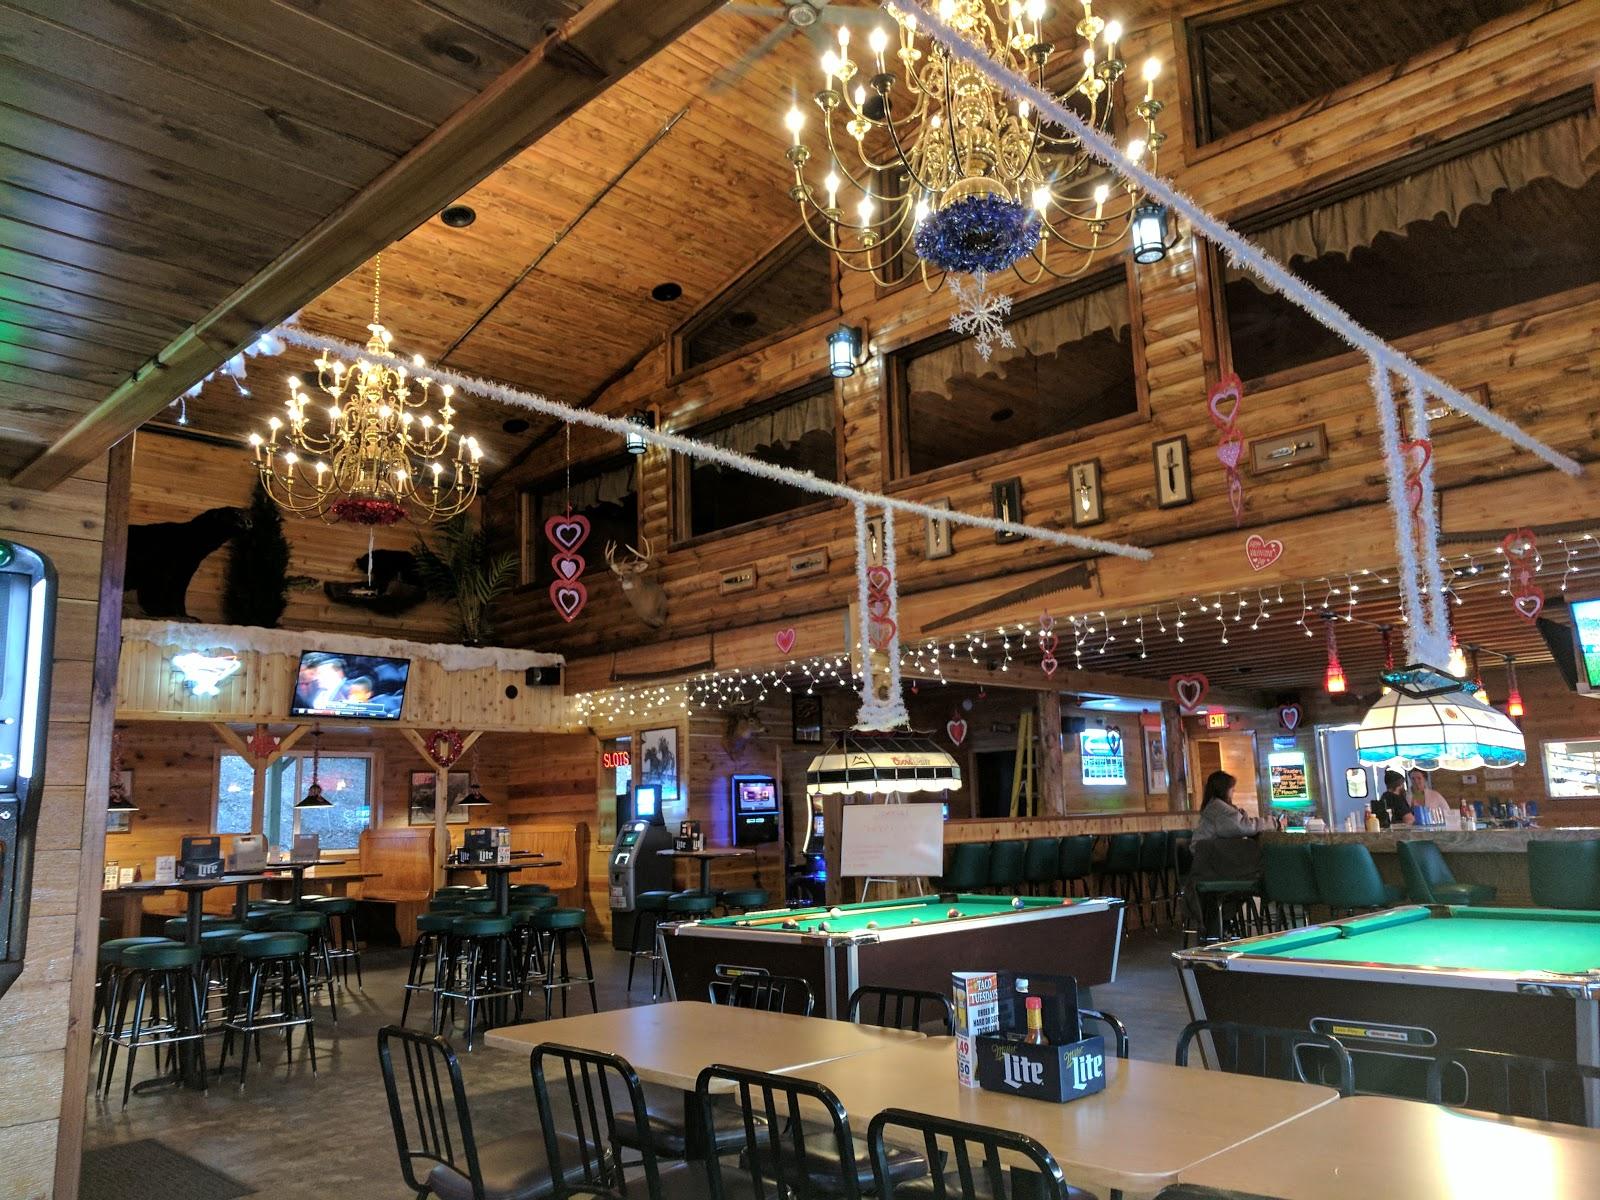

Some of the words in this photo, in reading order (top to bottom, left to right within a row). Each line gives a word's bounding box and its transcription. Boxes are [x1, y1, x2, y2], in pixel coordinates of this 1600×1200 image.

[603, 751, 630, 768] SLOTS
[198, 864, 218, 877] Lite
[977, 978, 992, 990] TACO
[1003, 1053, 1044, 1089] Lite
[1072, 1053, 1103, 1090] Lite
